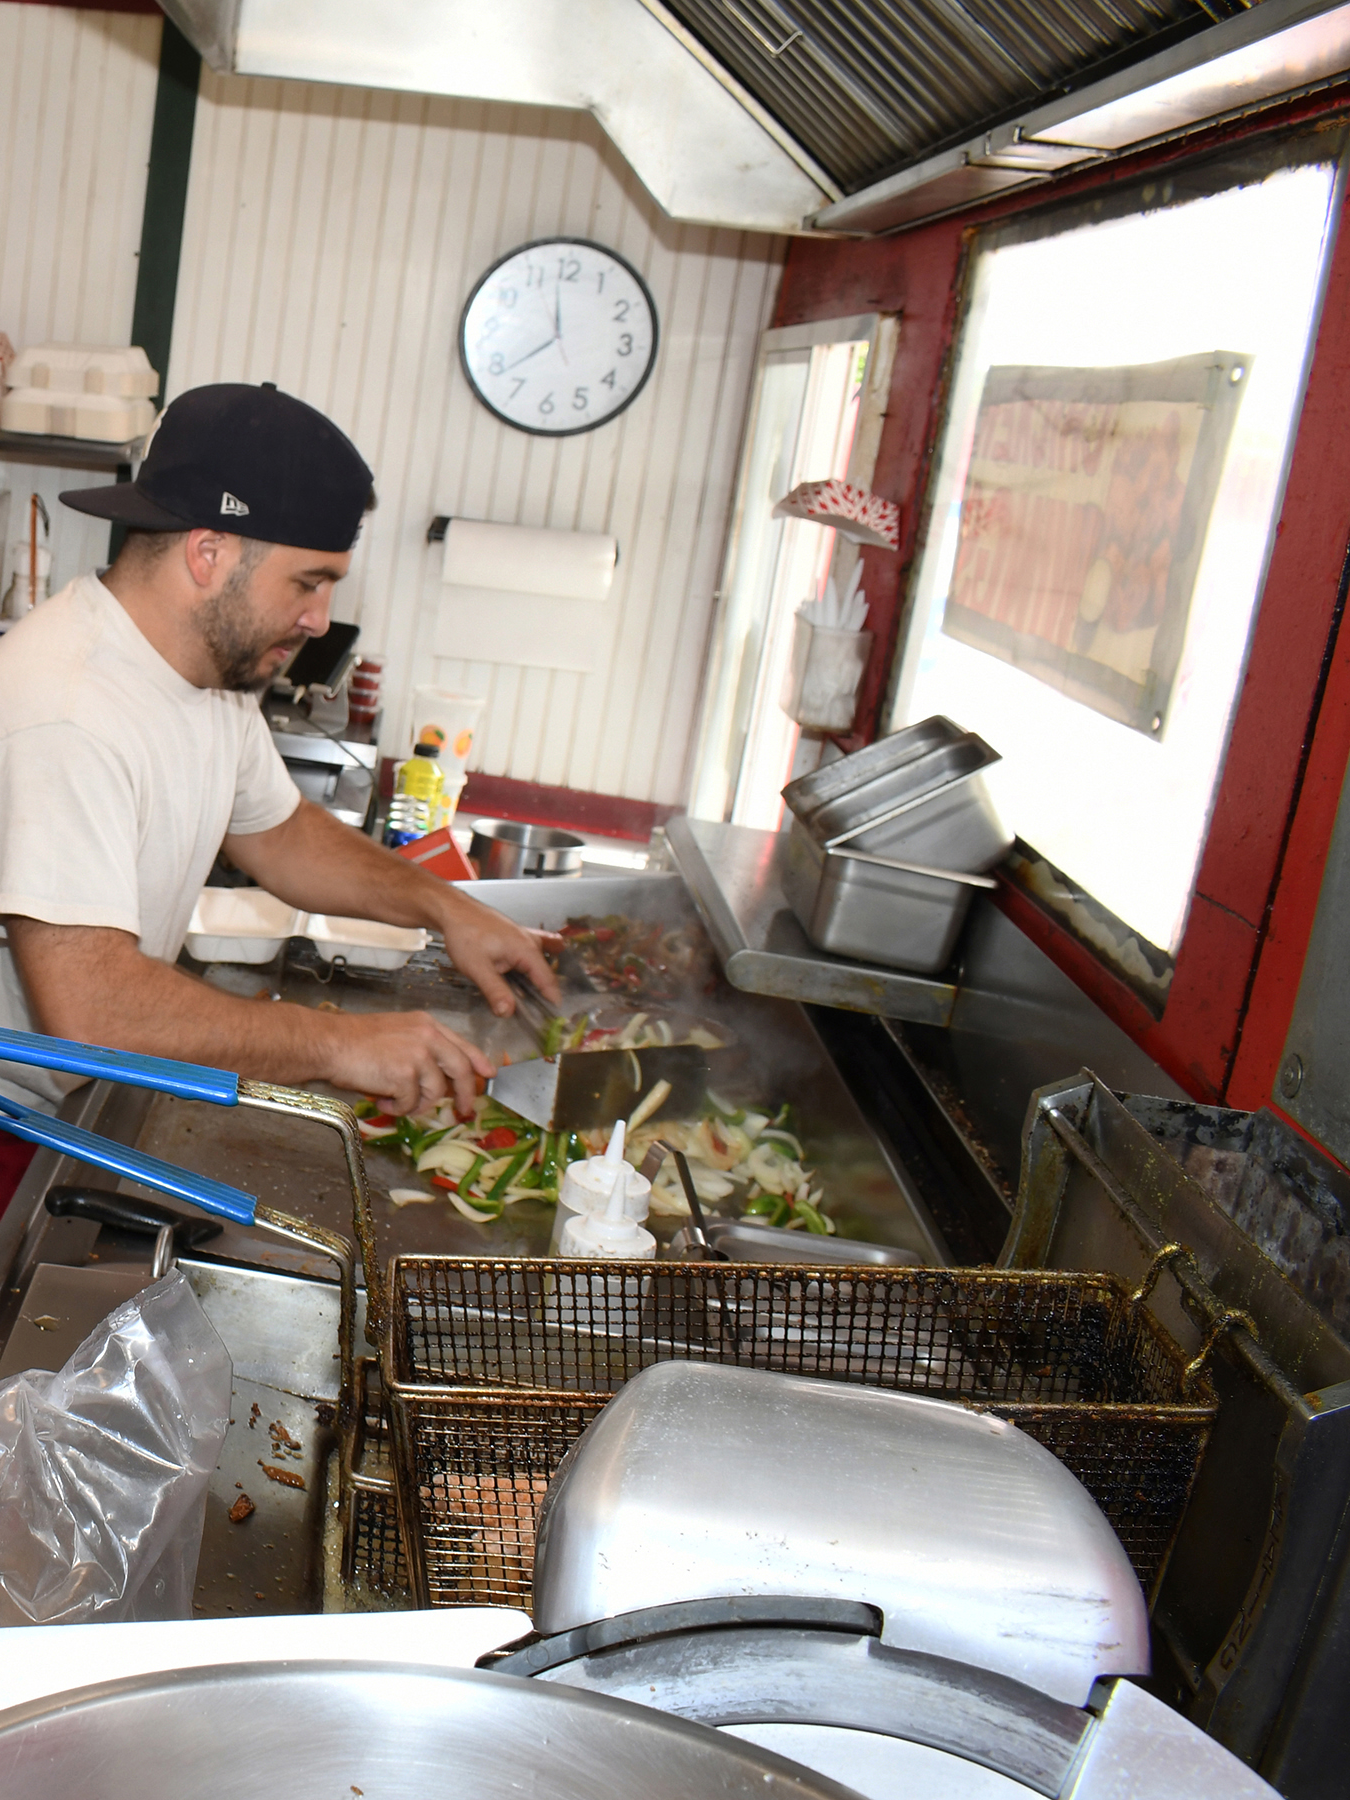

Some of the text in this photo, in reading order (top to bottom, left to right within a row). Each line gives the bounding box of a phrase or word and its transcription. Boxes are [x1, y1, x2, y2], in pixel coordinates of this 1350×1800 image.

[526, 264, 545, 288] 11
[558, 258, 581, 282] 12
[597, 272, 606, 294] 1
[613, 300, 631, 322] 2
[616, 333, 634, 357] 3
[488, 352, 505, 376] 8
[511, 377, 527, 400] 7
[600, 368, 617, 390] 4
[538, 391, 554, 415] 6
[572, 386, 589, 411] 5
